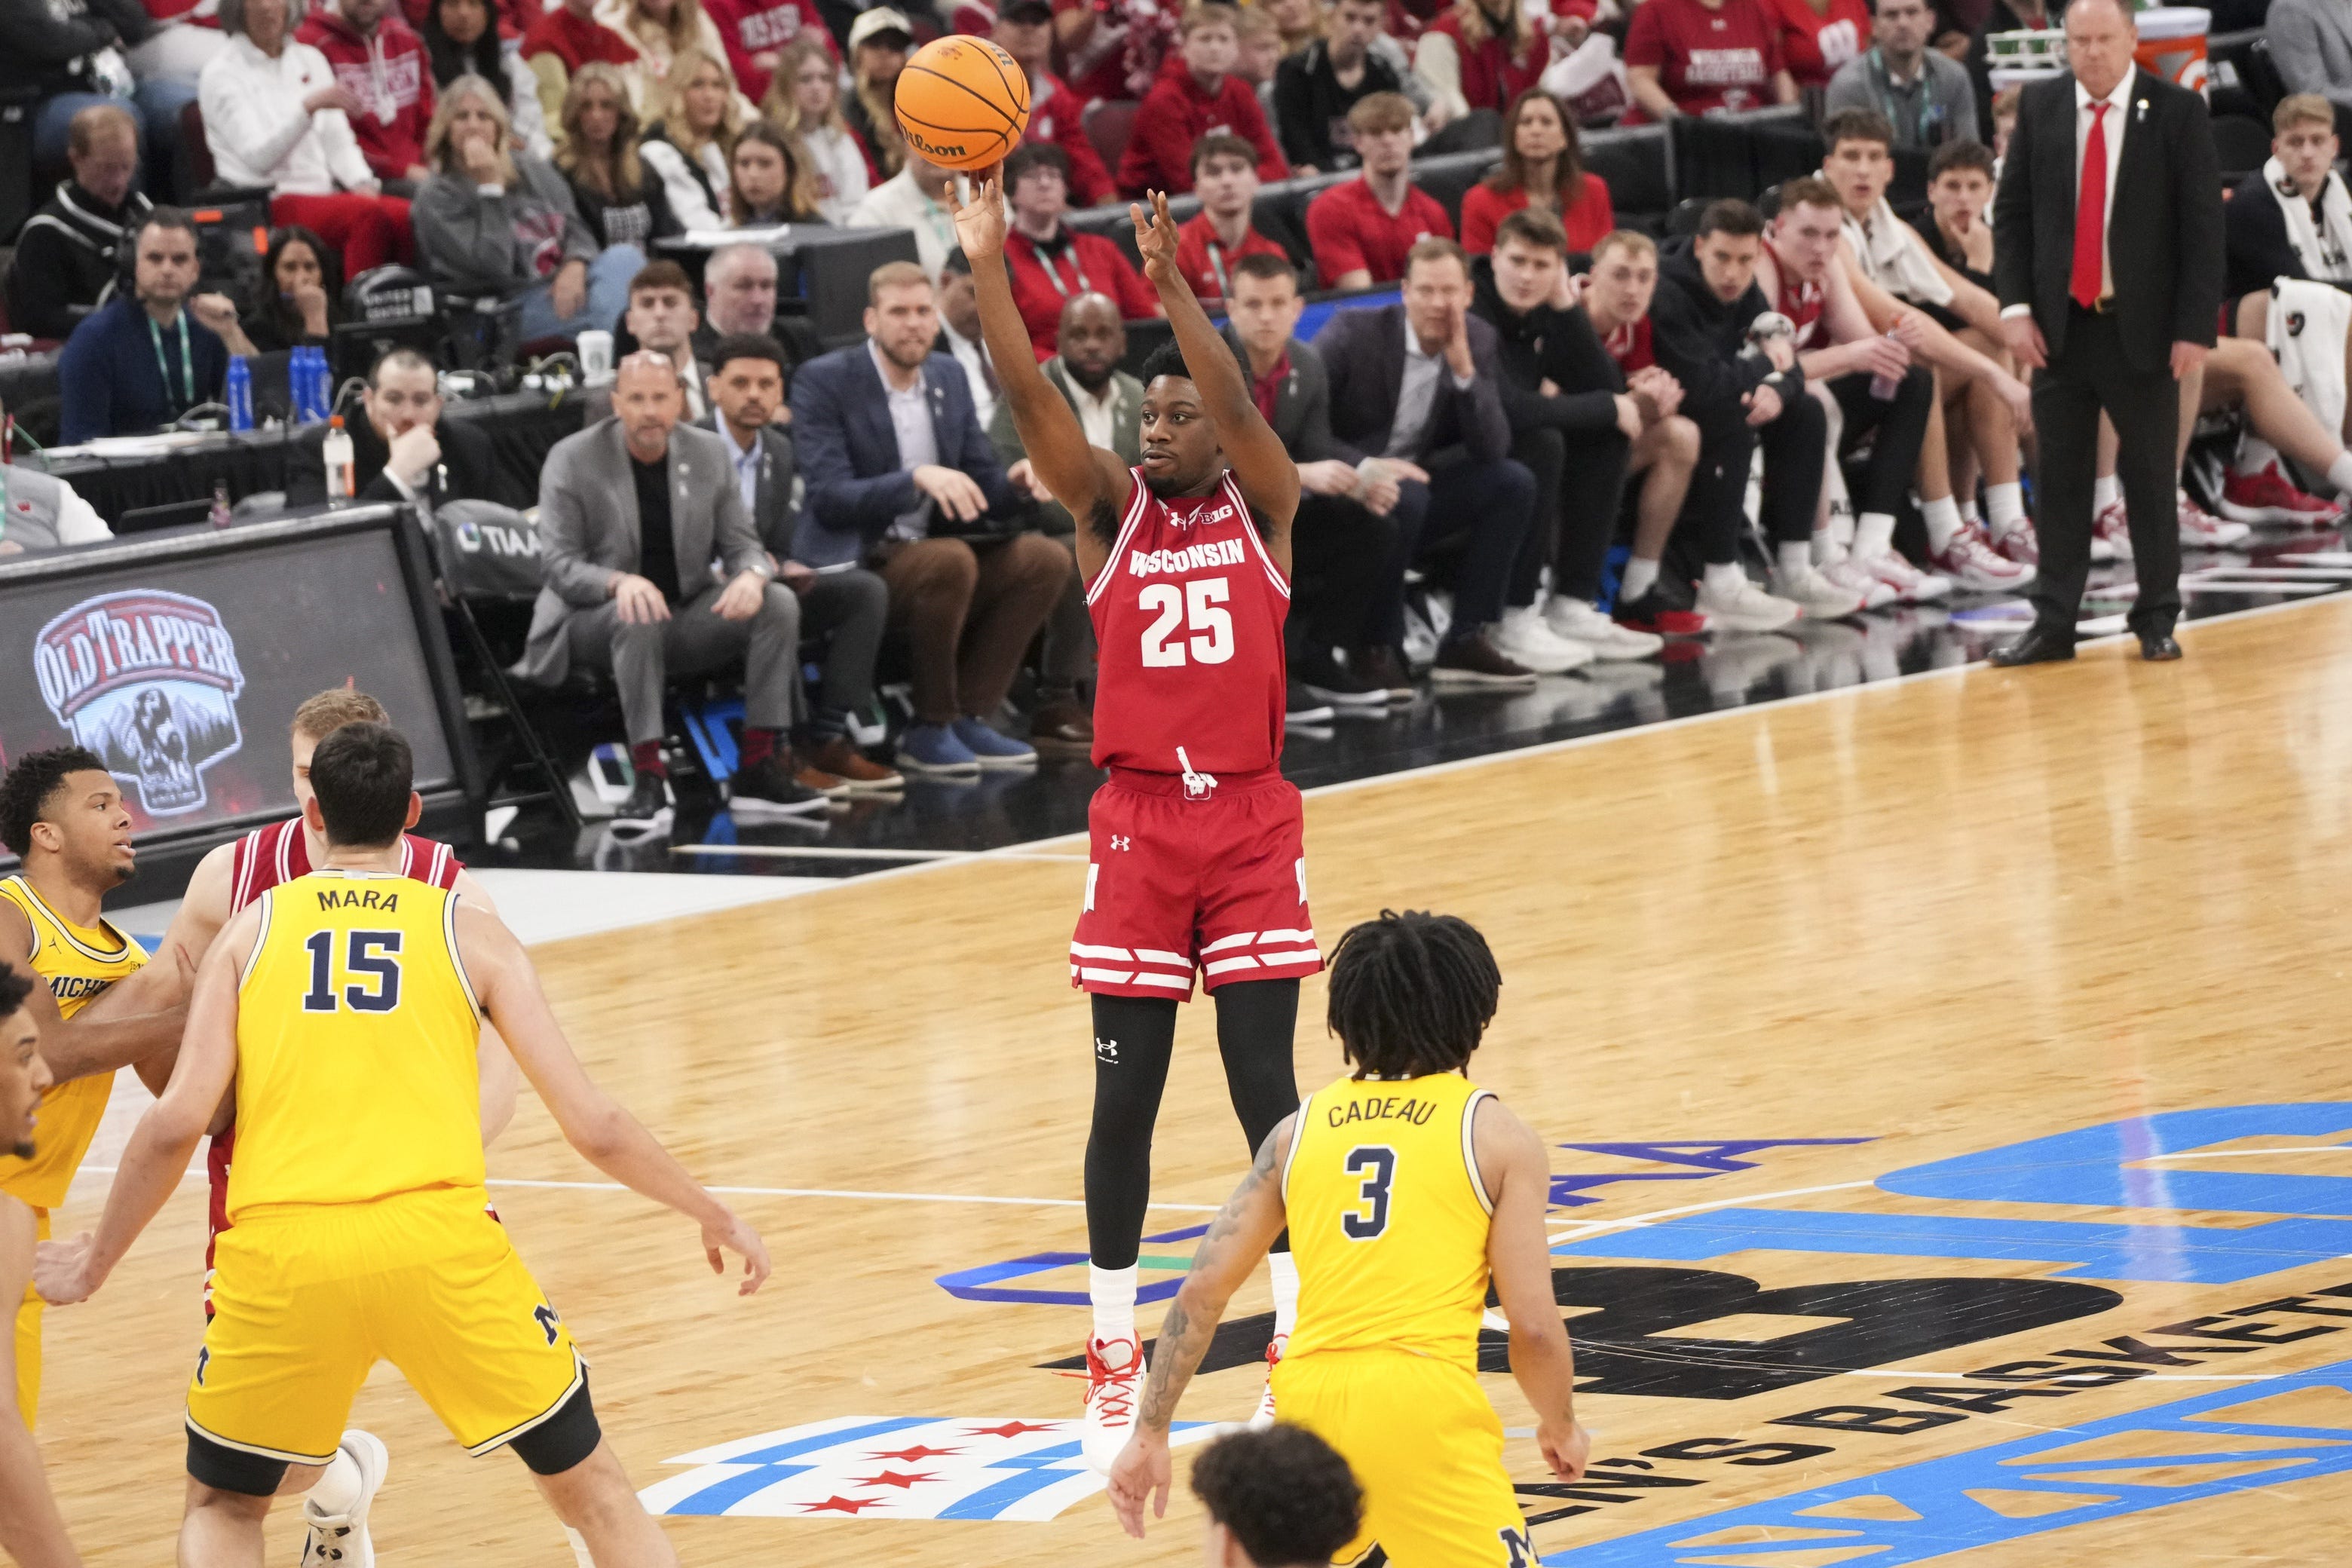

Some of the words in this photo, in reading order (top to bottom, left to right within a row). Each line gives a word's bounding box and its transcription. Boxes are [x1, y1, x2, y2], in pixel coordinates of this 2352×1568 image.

[1129, 537, 1245, 578] WSCONSIN
[40, 631, 98, 708] OLD
[86, 609, 236, 679] TRAPPER
[1138, 577, 1235, 667] 25
[317, 890, 399, 913] MARA
[303, 929, 404, 1014] 15
[1328, 1097, 1437, 1128] CADEAU
[1341, 1144, 1398, 1242] 3
[1764, 1282, 2352, 1435] BASKET
